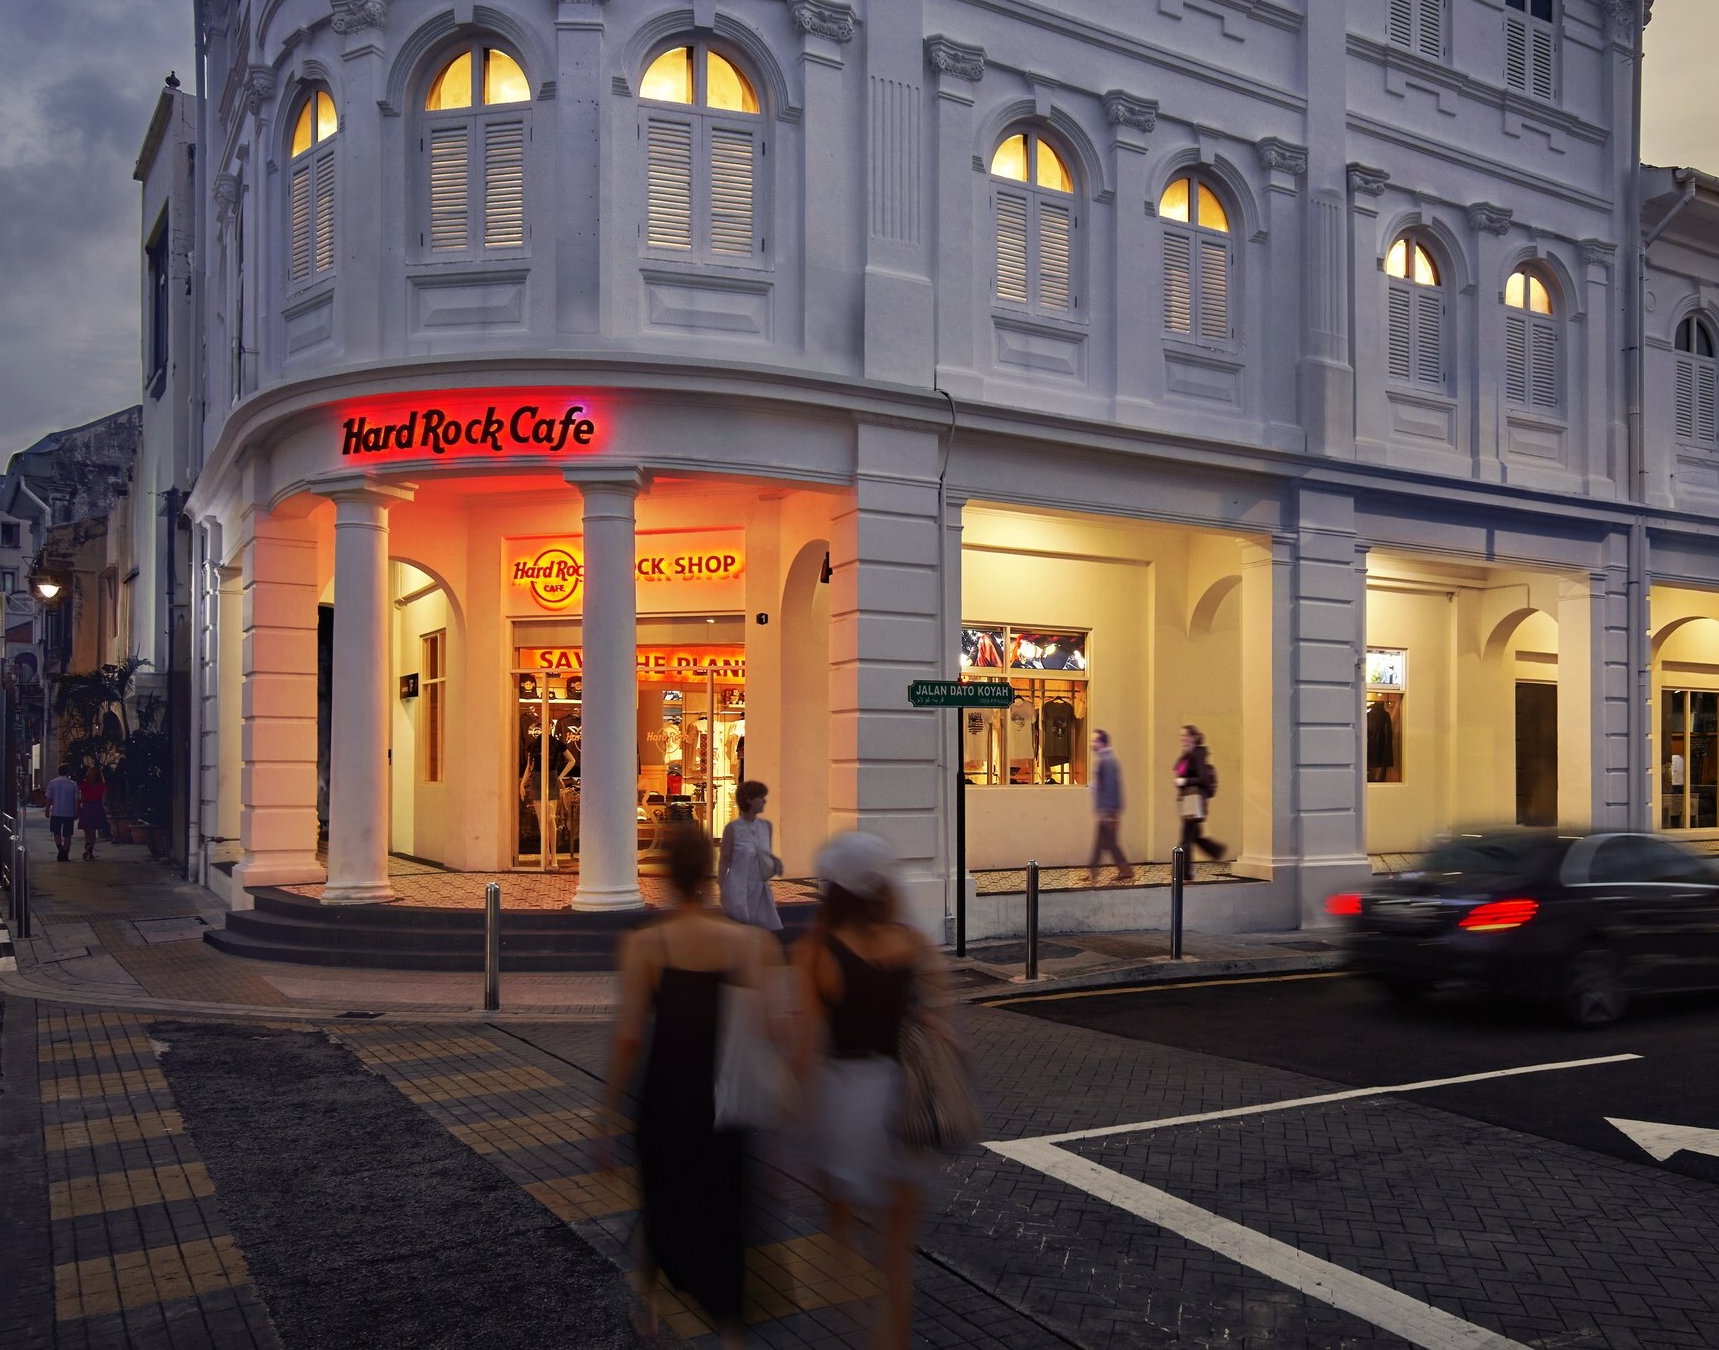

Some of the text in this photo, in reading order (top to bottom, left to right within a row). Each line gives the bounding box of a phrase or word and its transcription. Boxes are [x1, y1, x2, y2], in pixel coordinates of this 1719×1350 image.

[342, 406, 594, 455] Hard Rock Cafe
[513, 560, 584, 581] Hard Roc
[635, 555, 736, 575] CK SHOP
[543, 584, 566, 593] CAFE
[539, 651, 745, 678] SAV HE PLAN
[916, 685, 1009, 697] JALAN DATO KOYAH
